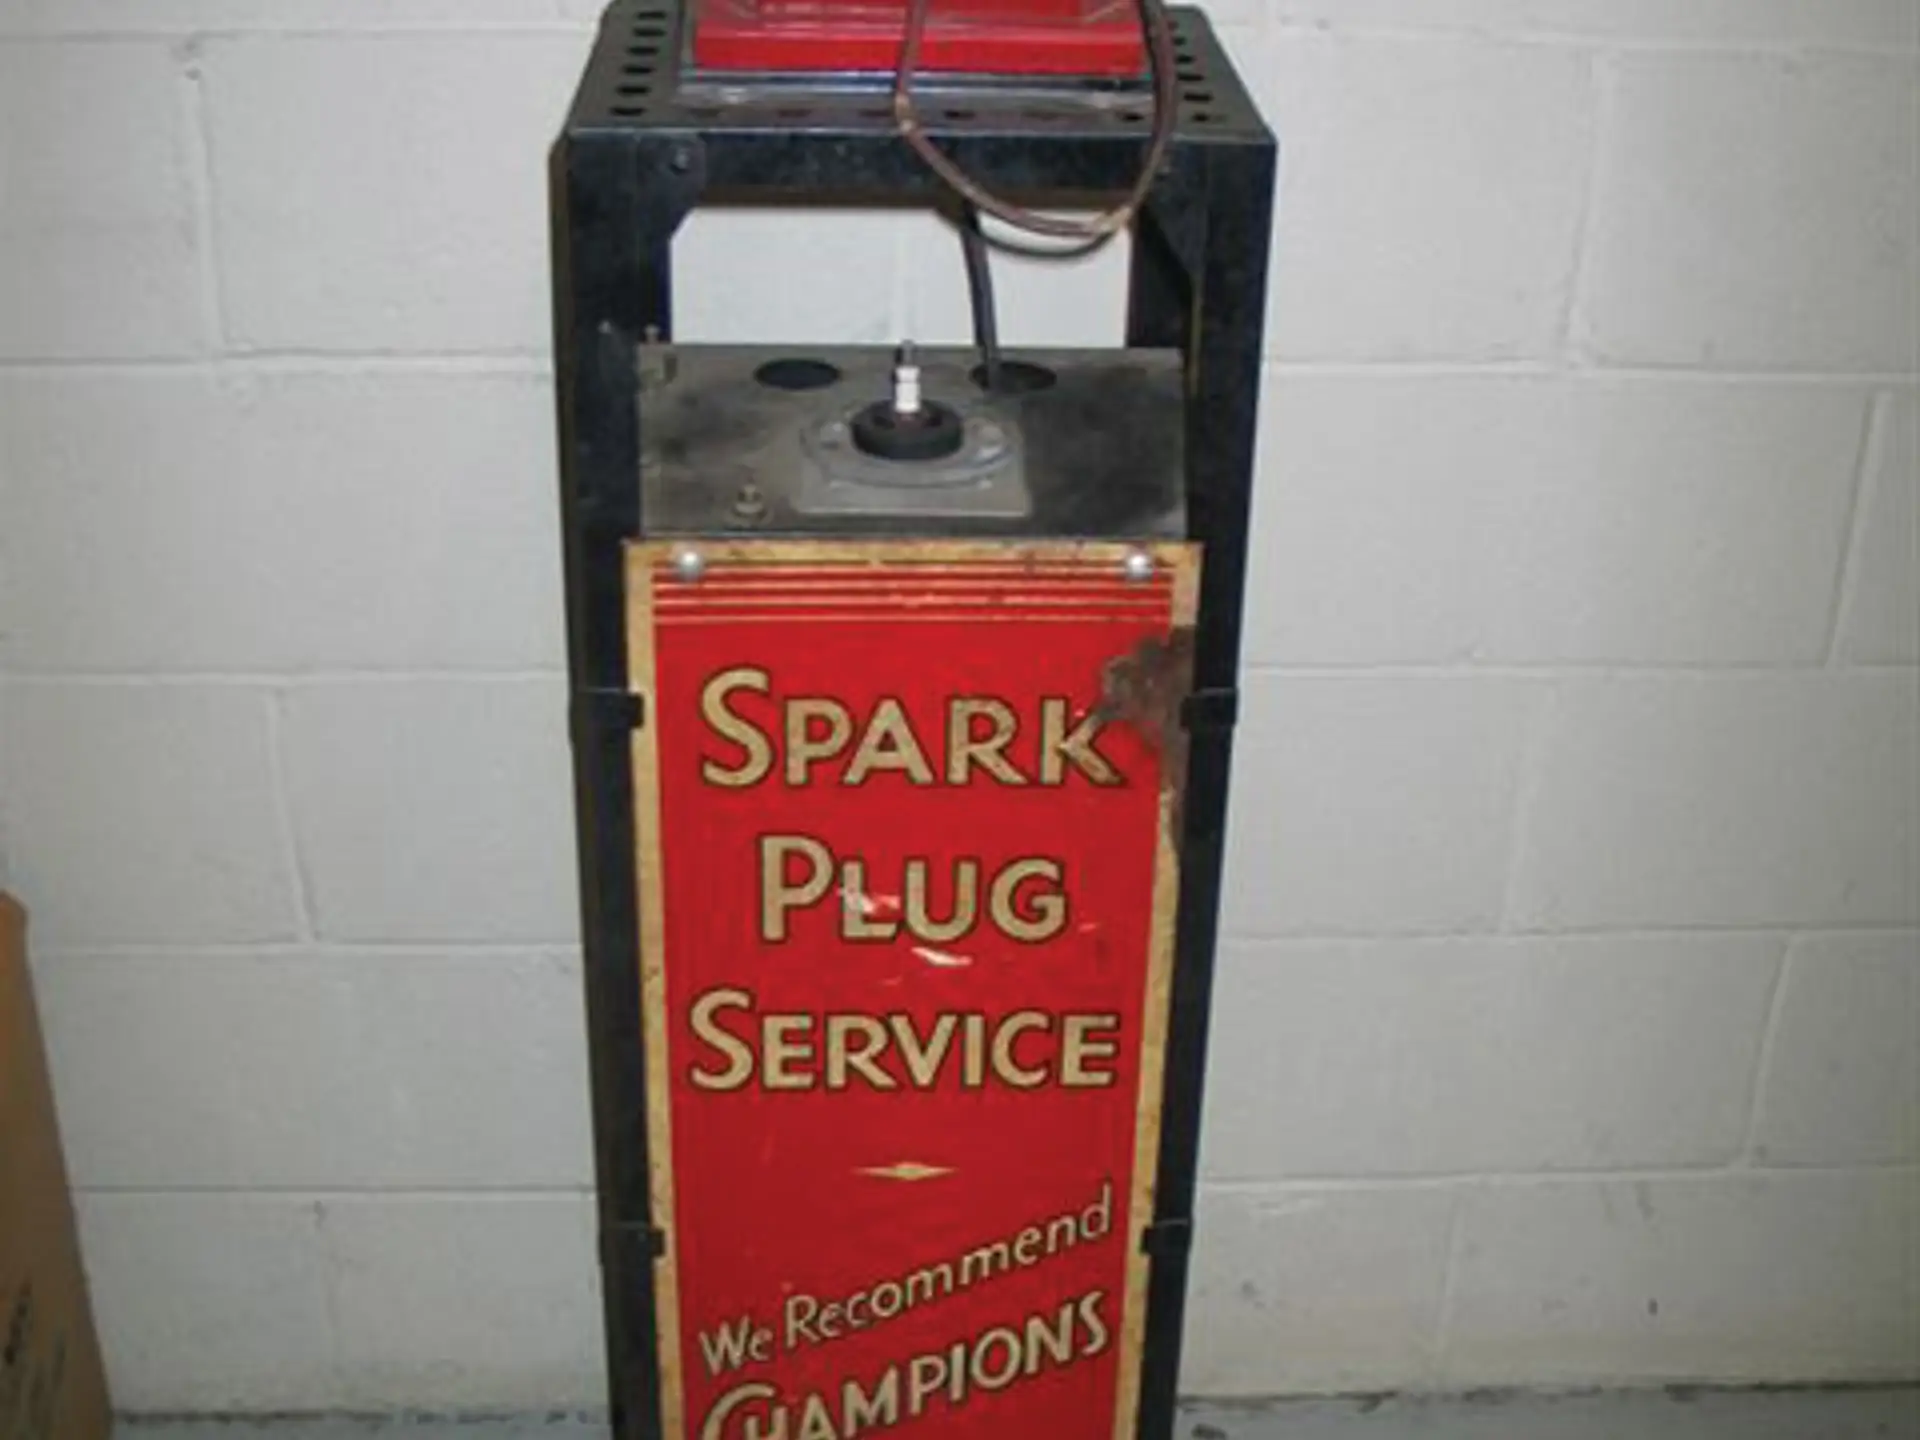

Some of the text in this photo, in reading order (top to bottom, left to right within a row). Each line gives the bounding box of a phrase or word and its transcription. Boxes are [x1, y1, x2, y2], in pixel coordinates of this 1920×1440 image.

[700, 666, 1123, 787] SPARK
[758, 832, 1068, 943] PLUG
[688, 988, 1121, 1090] SERVICE
[698, 1181, 1113, 1377] We Recommend
[700, 1289, 1112, 1440] CHAMPIONS
